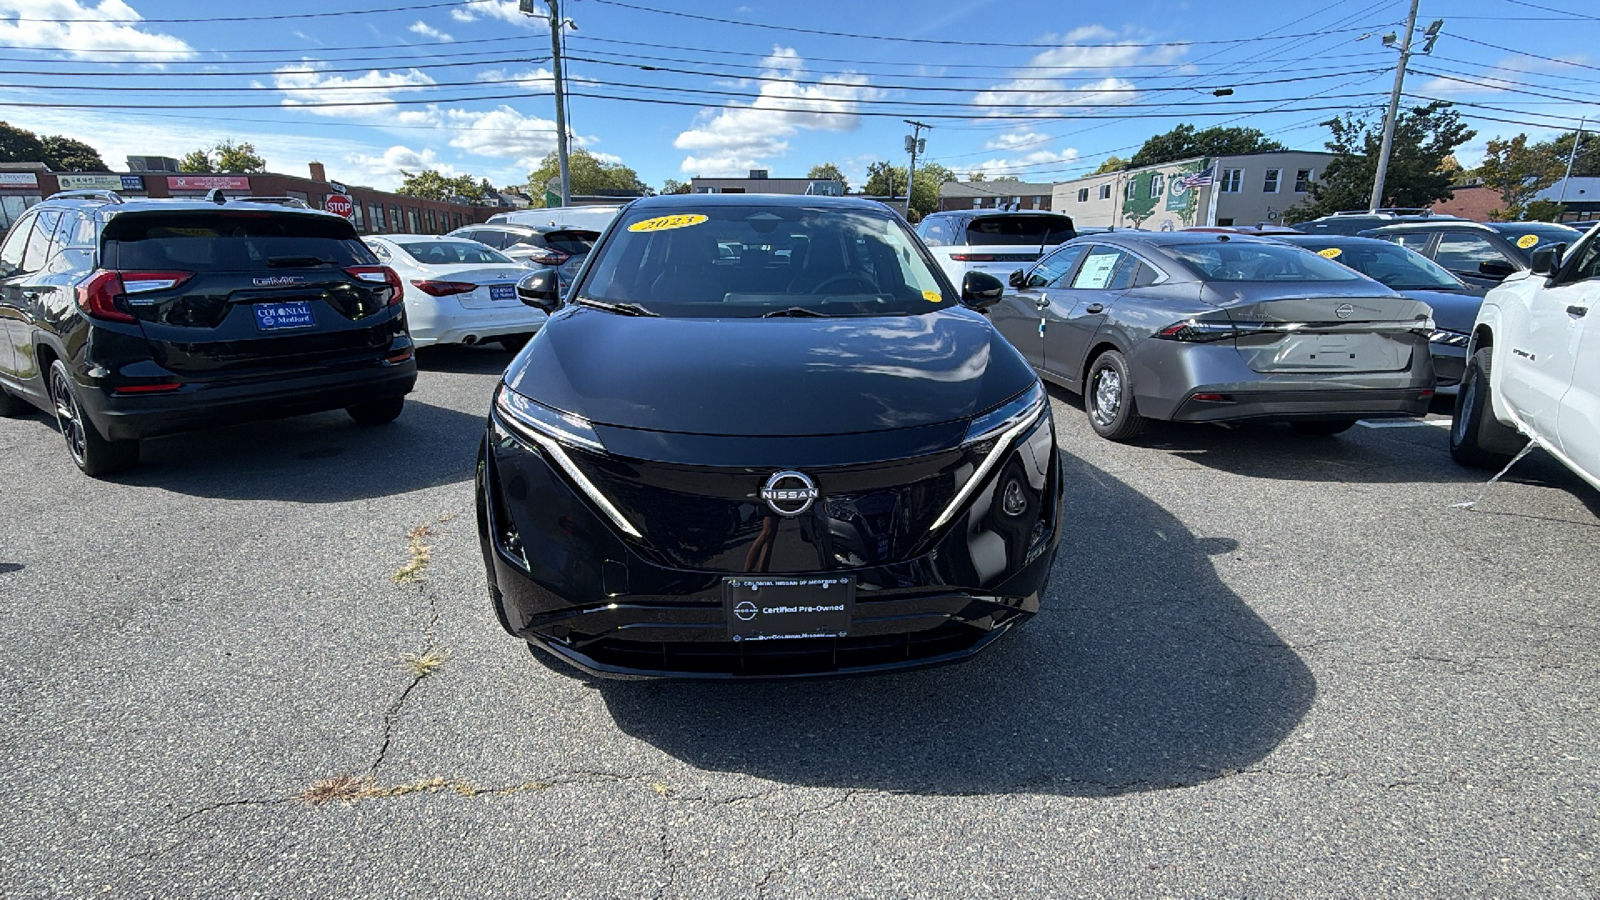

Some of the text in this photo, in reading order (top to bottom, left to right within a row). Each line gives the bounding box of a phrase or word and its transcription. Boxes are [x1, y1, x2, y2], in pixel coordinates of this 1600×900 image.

[328, 202, 350, 212] STOP
[641, 216, 695, 230] 2023
[253, 276, 304, 287] GMC
[257, 306, 310, 317] COLONIAL
[277, 315, 310, 324] Medford
[762, 490, 818, 499] NISSAN
[762, 604, 844, 614] Certified Pre-Owned
